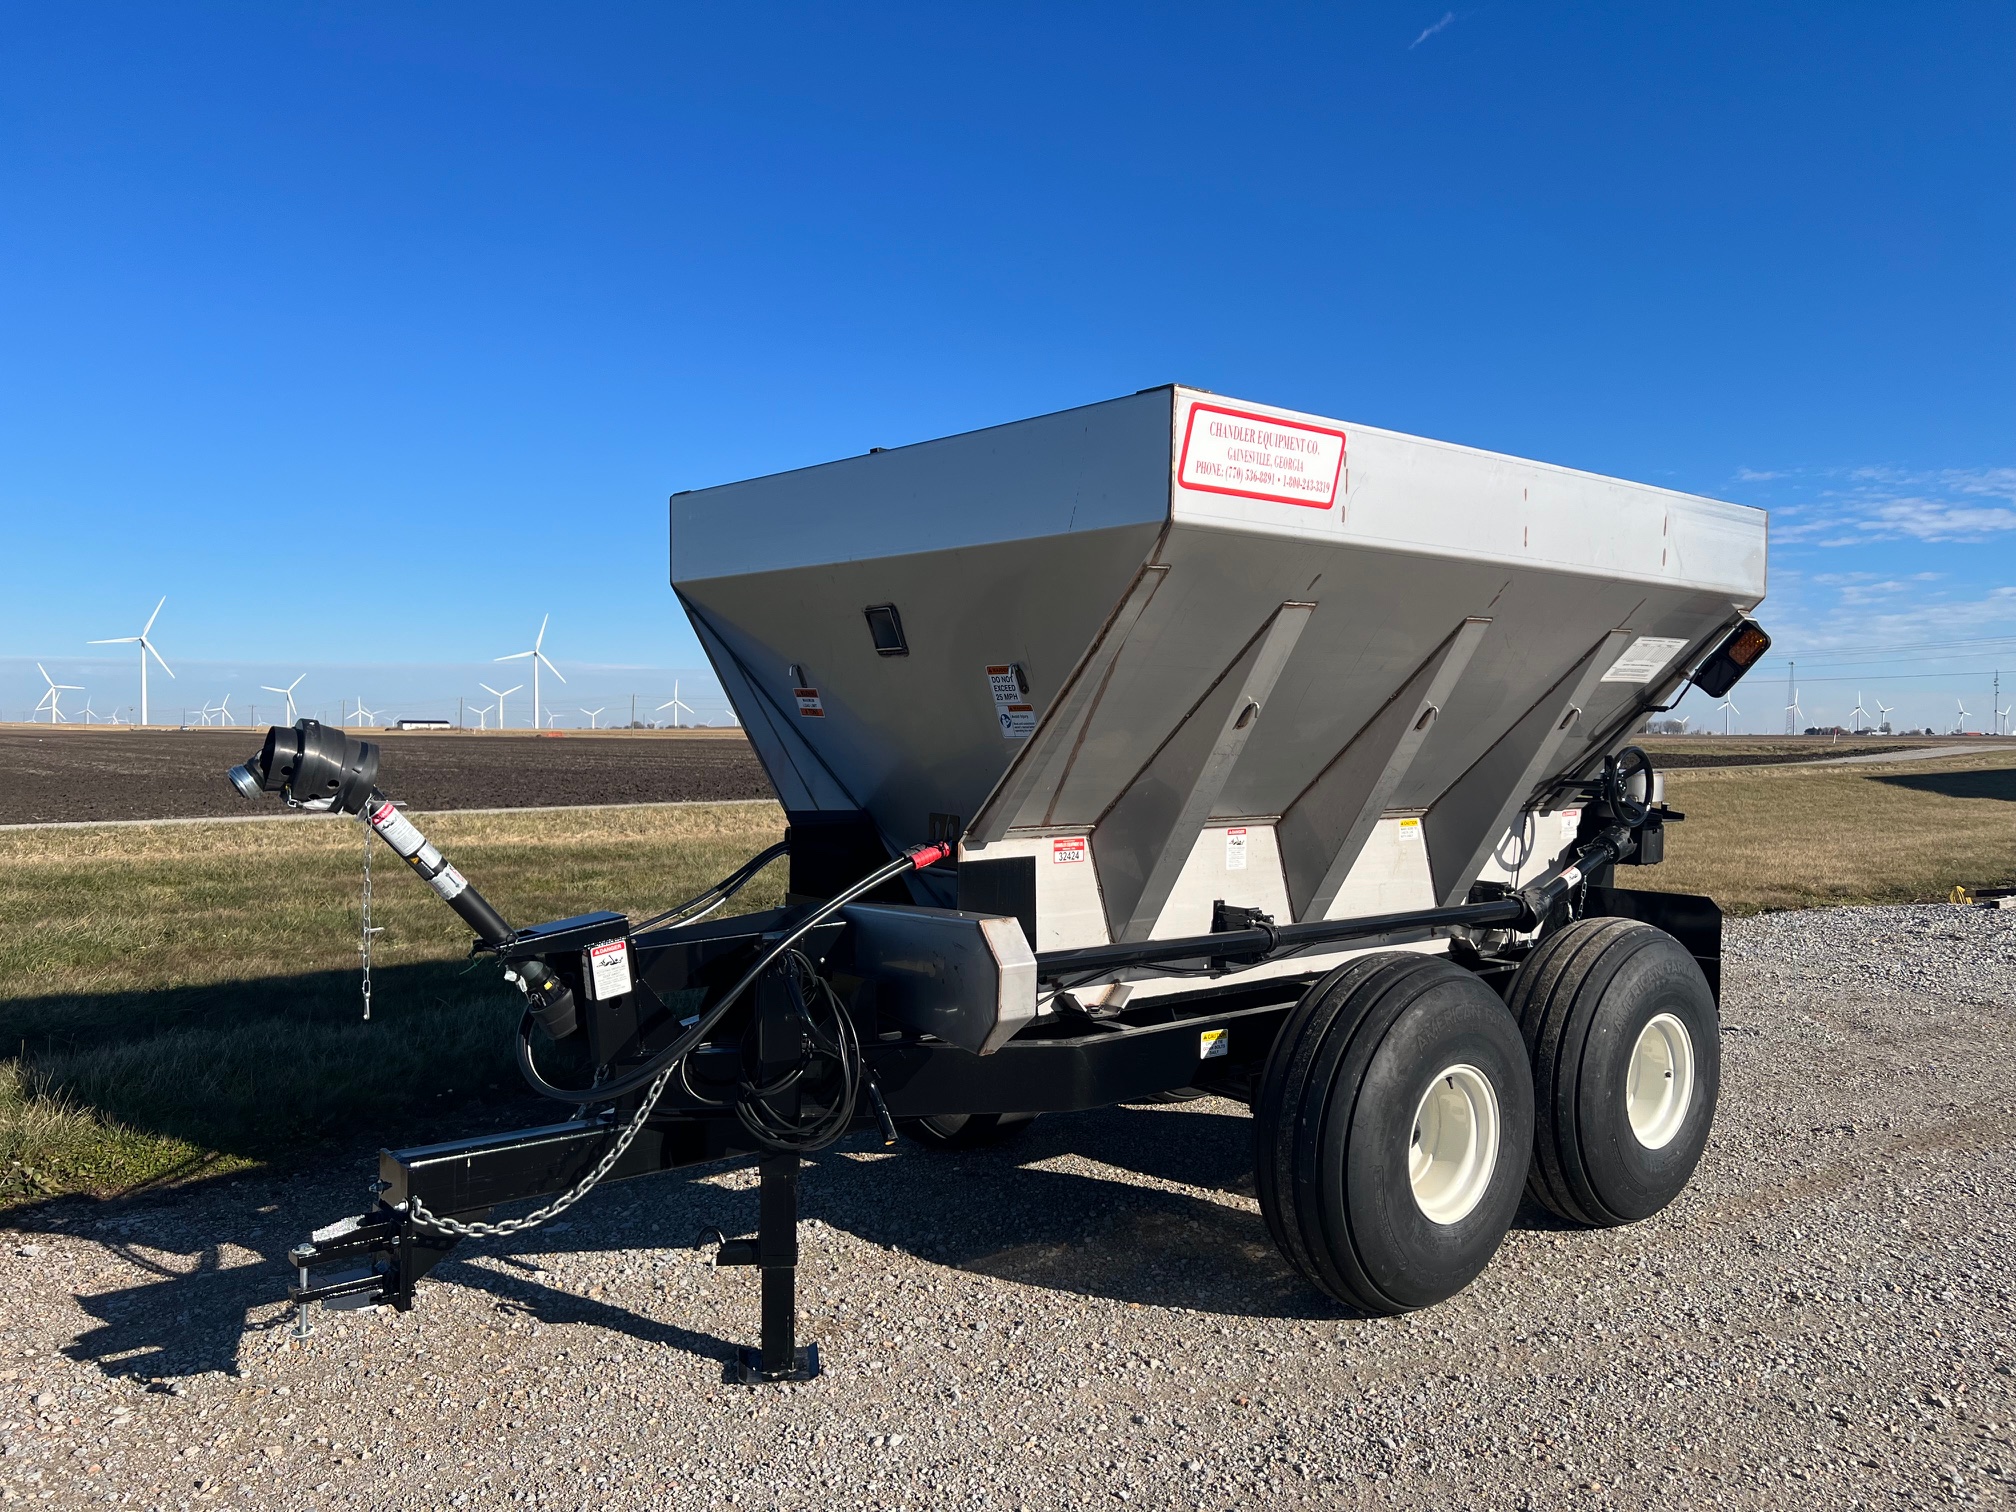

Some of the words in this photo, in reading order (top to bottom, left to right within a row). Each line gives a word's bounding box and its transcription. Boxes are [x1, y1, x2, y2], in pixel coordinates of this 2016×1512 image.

[1209, 421, 1256, 444] CHANDLER
[1257, 430, 1306, 453] EQUIPMENT
[1306, 440, 1320, 455] CO.
[1227, 447, 1273, 469] GAINESVILLE,
[1273, 455, 1304, 472] GEORGIA
[1195, 460, 1224, 477] PHONE:
[1225, 466, 1244, 484] (770)
[1244, 469, 1275, 486] 536-8891
[1283, 475, 1331, 494] 1-800-243-3319
[1001, 675, 1014, 683] NOT
[993, 684, 1016, 692] EXCEED
[995, 693, 1003, 701] 25
[1058, 851, 1080, 861] 32424
[600, 943, 622, 953] DANGER
[1613, 963, 1665, 1033] AMERICAN
[1417, 1003, 1481, 1052] AMERICAN
[1207, 1031, 1227, 1039] CAUTION
